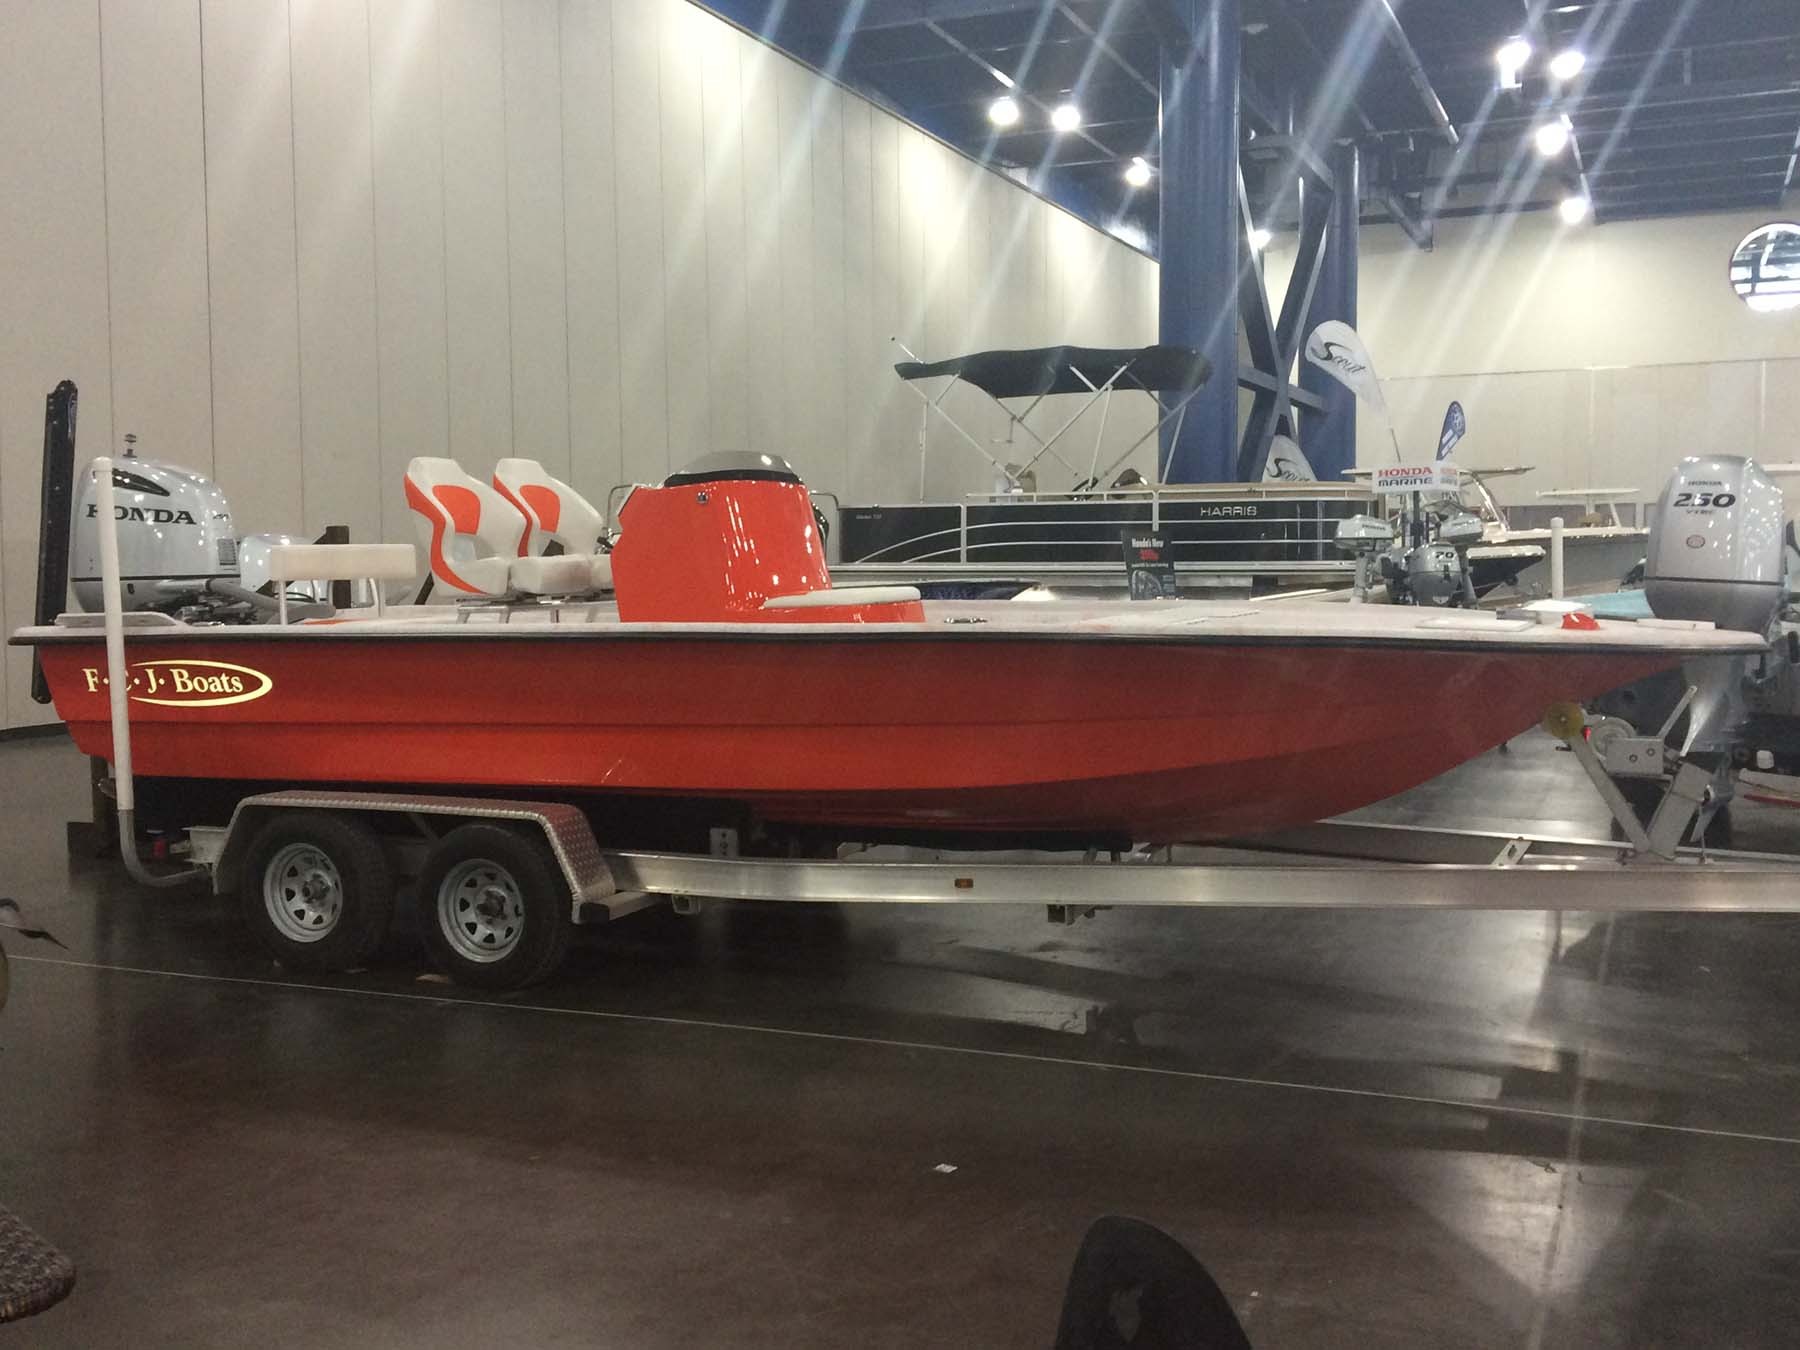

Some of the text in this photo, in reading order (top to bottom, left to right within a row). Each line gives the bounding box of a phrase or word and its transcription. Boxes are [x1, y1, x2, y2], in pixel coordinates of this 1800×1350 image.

[1310, 342, 1367, 374] Scout
[1265, 457, 1311, 481] Sco
[1378, 466, 1433, 478] HONDA
[1673, 493, 1736, 508] 250
[1200, 505, 1257, 517] HARRIS
[170, 668, 244, 693] Boats
